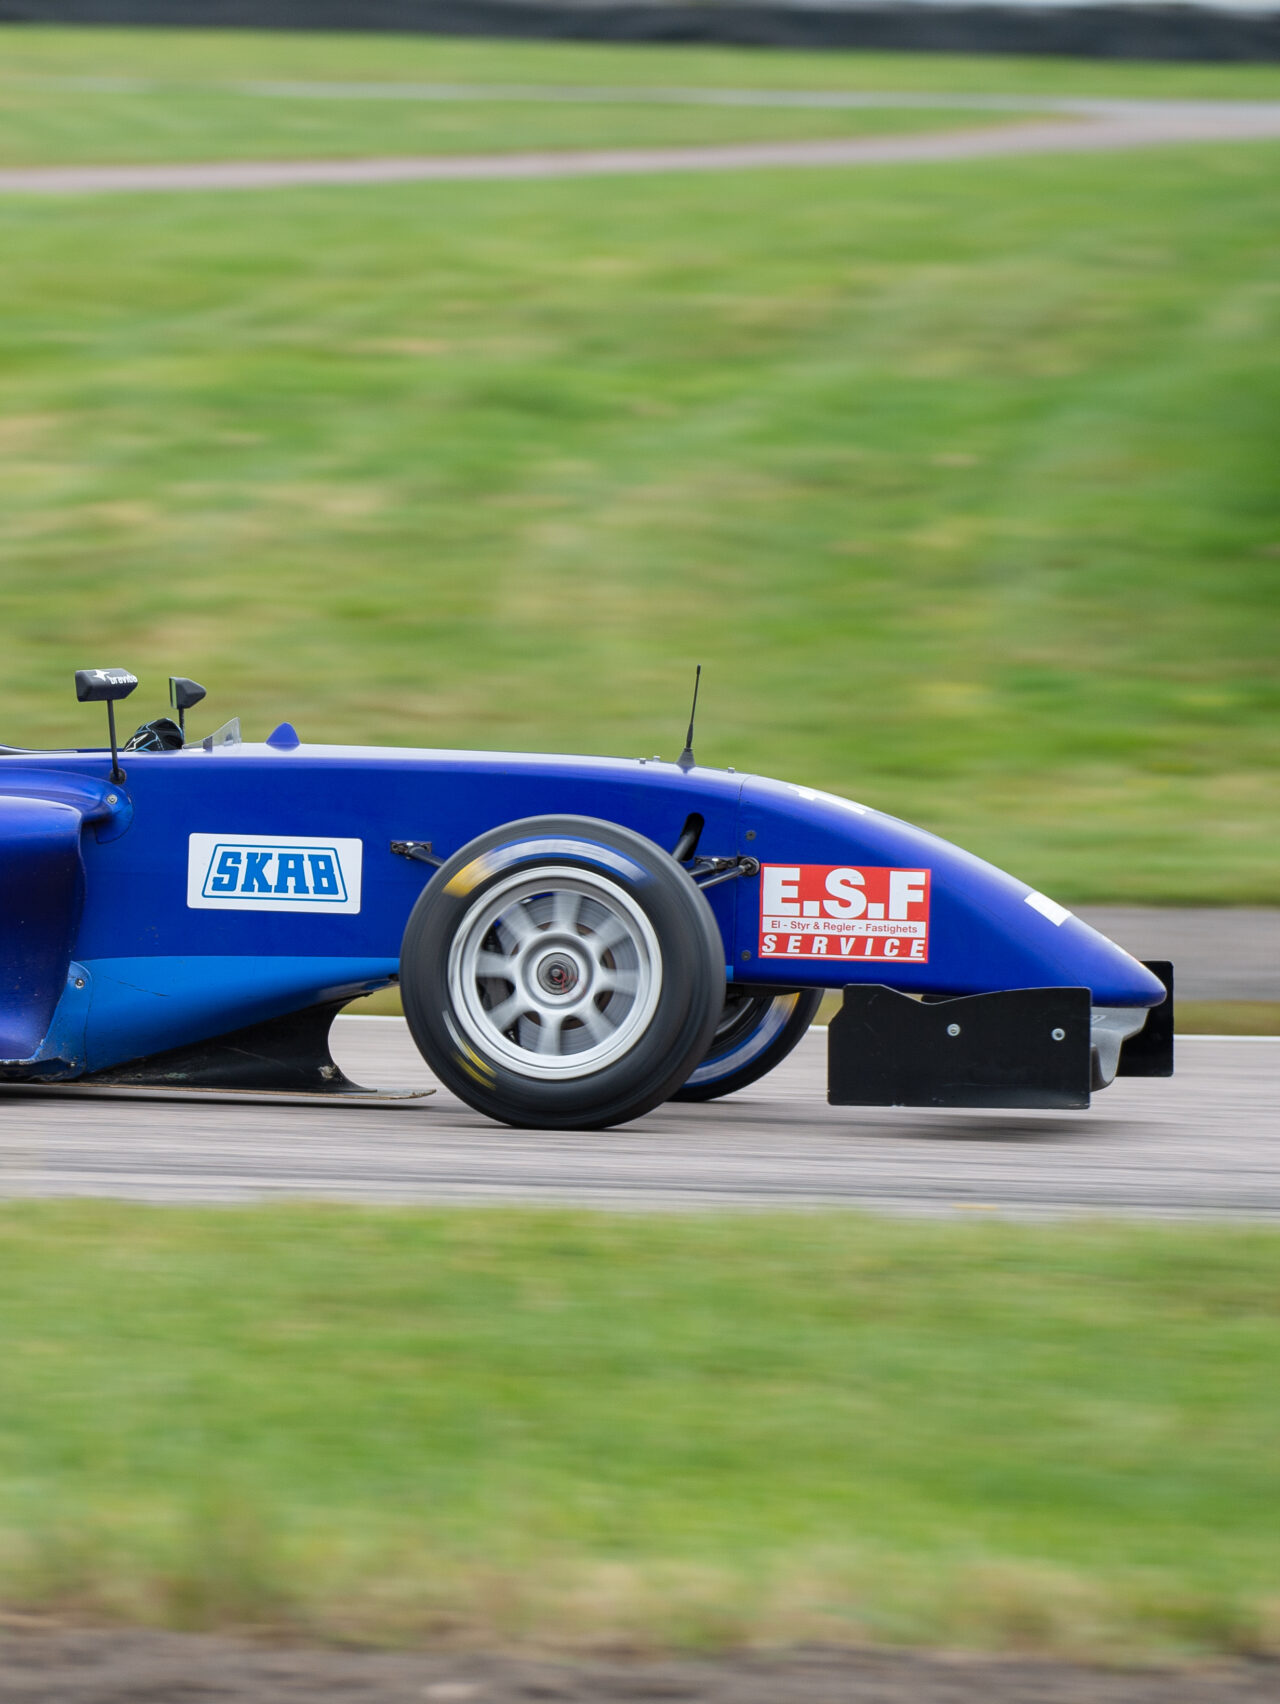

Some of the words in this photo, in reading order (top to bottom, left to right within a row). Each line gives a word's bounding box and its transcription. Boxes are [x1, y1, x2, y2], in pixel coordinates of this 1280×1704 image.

[211, 851, 339, 896] SKAB
[762, 866, 926, 920] E.S.F
[790, 921, 811, 931] Styr
[813, 921, 820, 931] &
[823, 922, 856, 934] Regler
[865, 924, 918, 935] Fastighets
[762, 934, 925, 957] SERVICE
